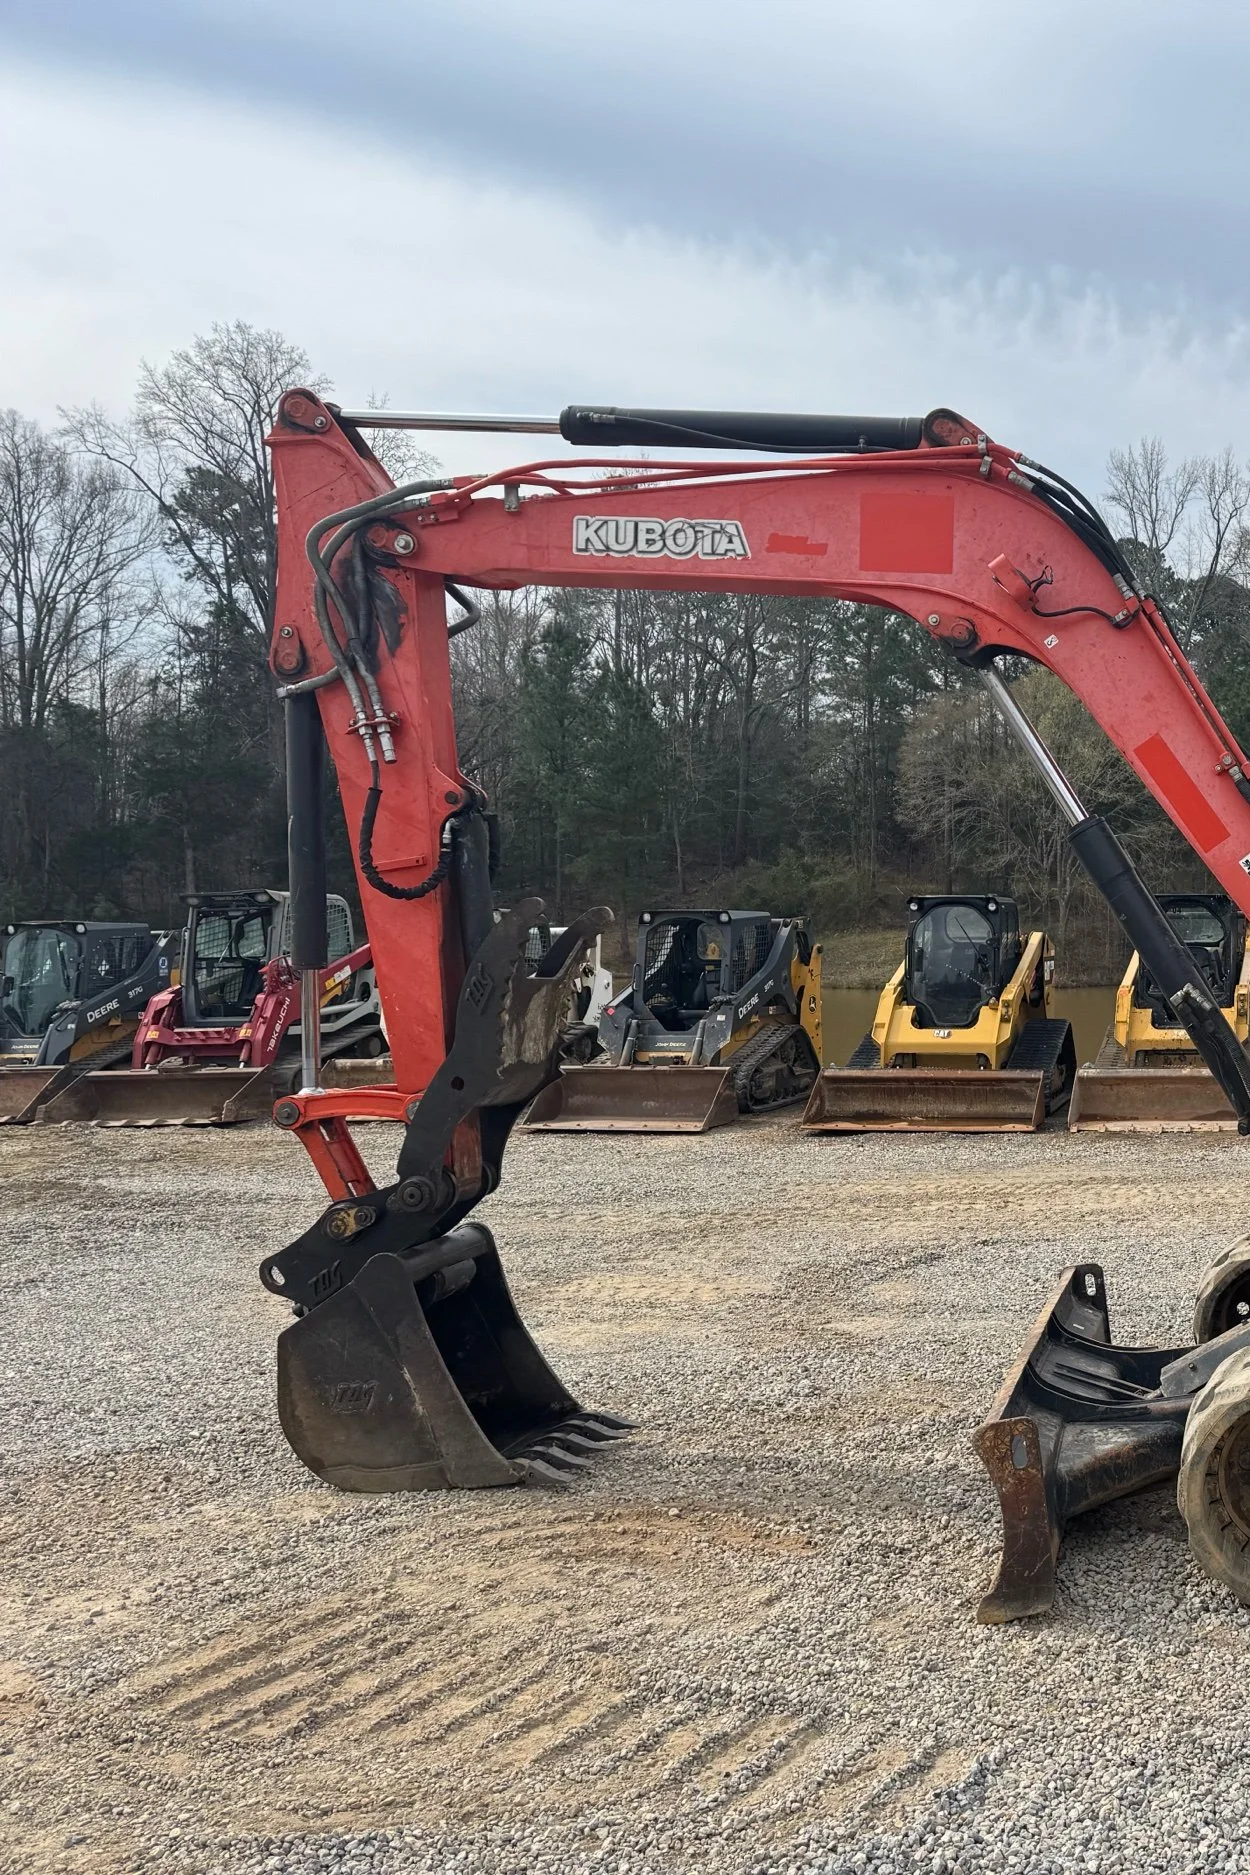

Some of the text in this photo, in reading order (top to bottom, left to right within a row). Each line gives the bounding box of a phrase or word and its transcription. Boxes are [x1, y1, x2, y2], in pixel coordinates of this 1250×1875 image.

[574, 517, 751, 559] KUBOTA
[86, 998, 120, 1023] DEERE
[738, 992, 760, 1020] DEERE
